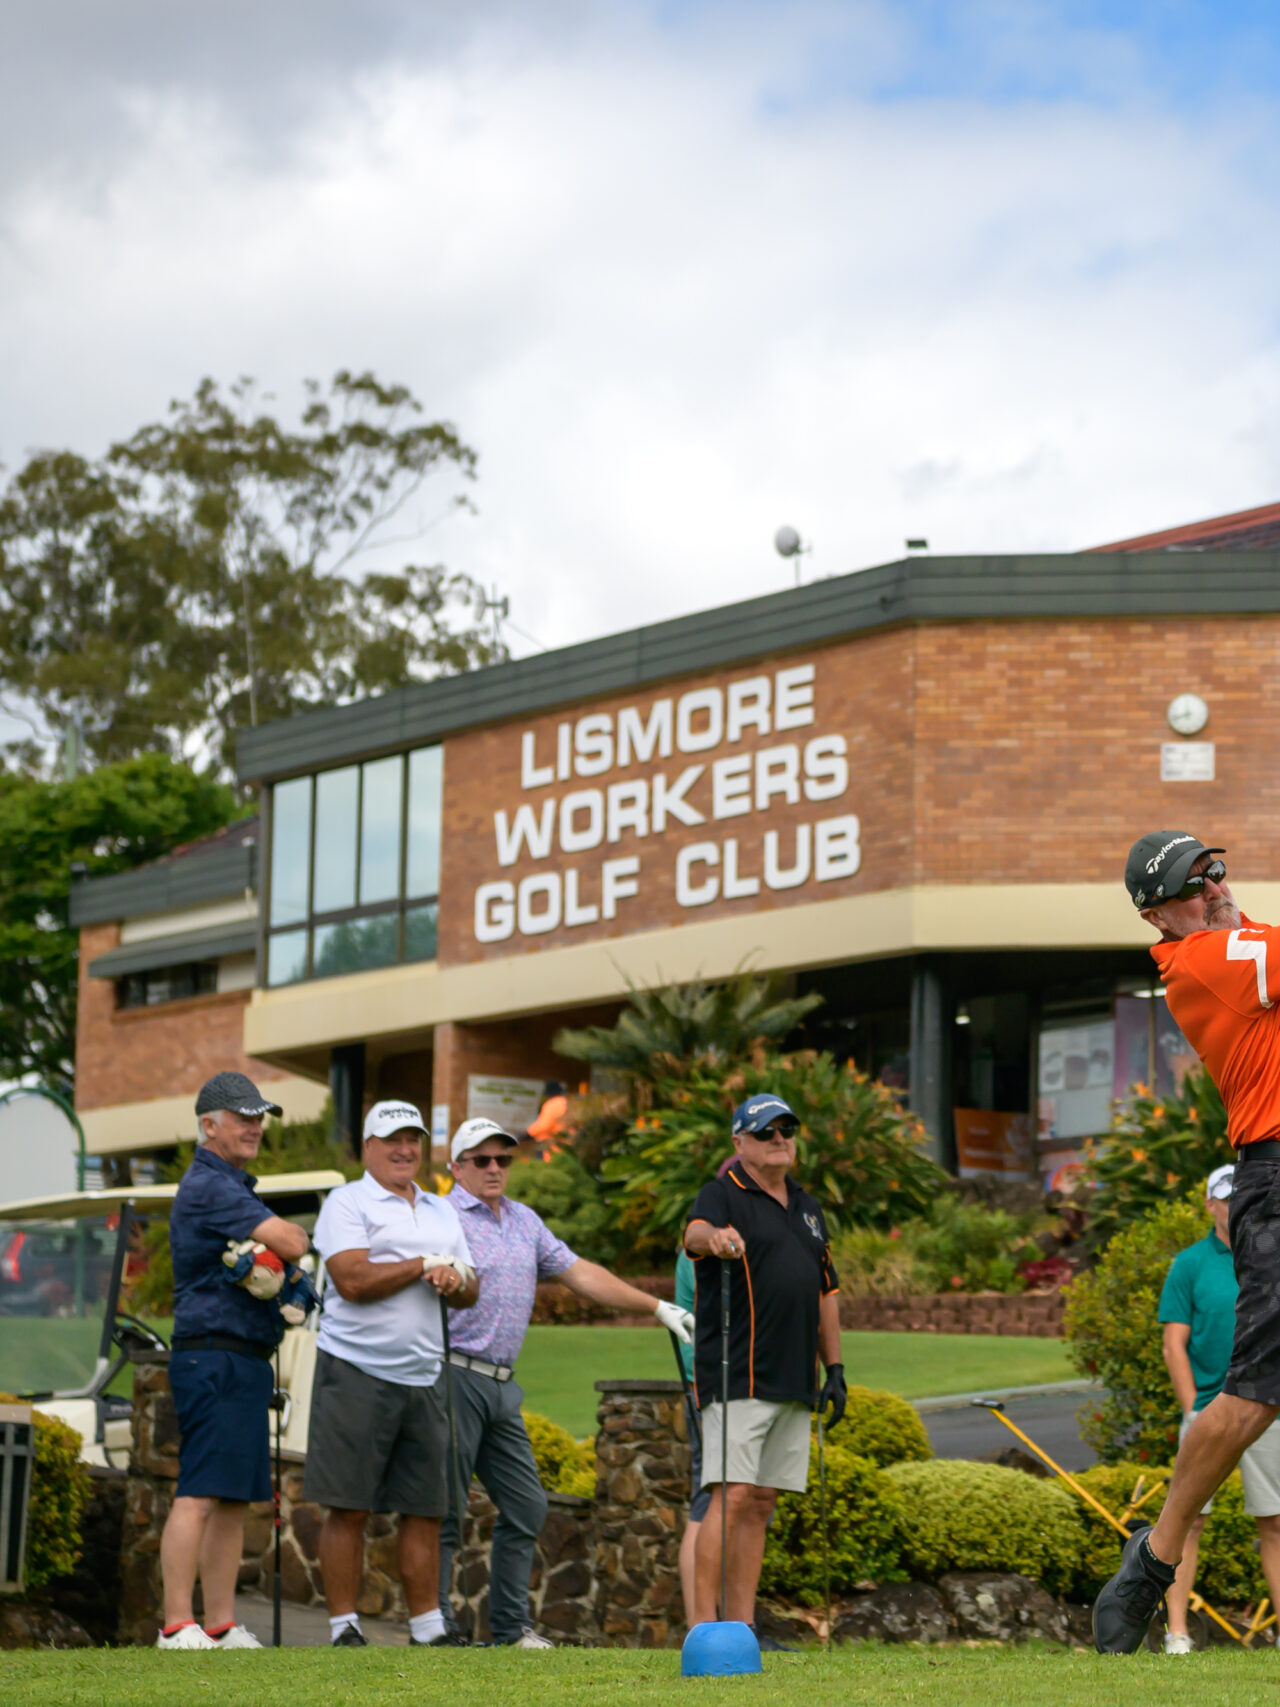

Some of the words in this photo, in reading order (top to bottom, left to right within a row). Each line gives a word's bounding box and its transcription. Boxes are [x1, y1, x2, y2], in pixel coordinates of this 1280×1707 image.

[520, 663, 816, 790] LISMORE
[494, 734, 850, 867] WORKERS
[474, 856, 640, 943] GOLF
[675, 814, 861, 908] CLUB
